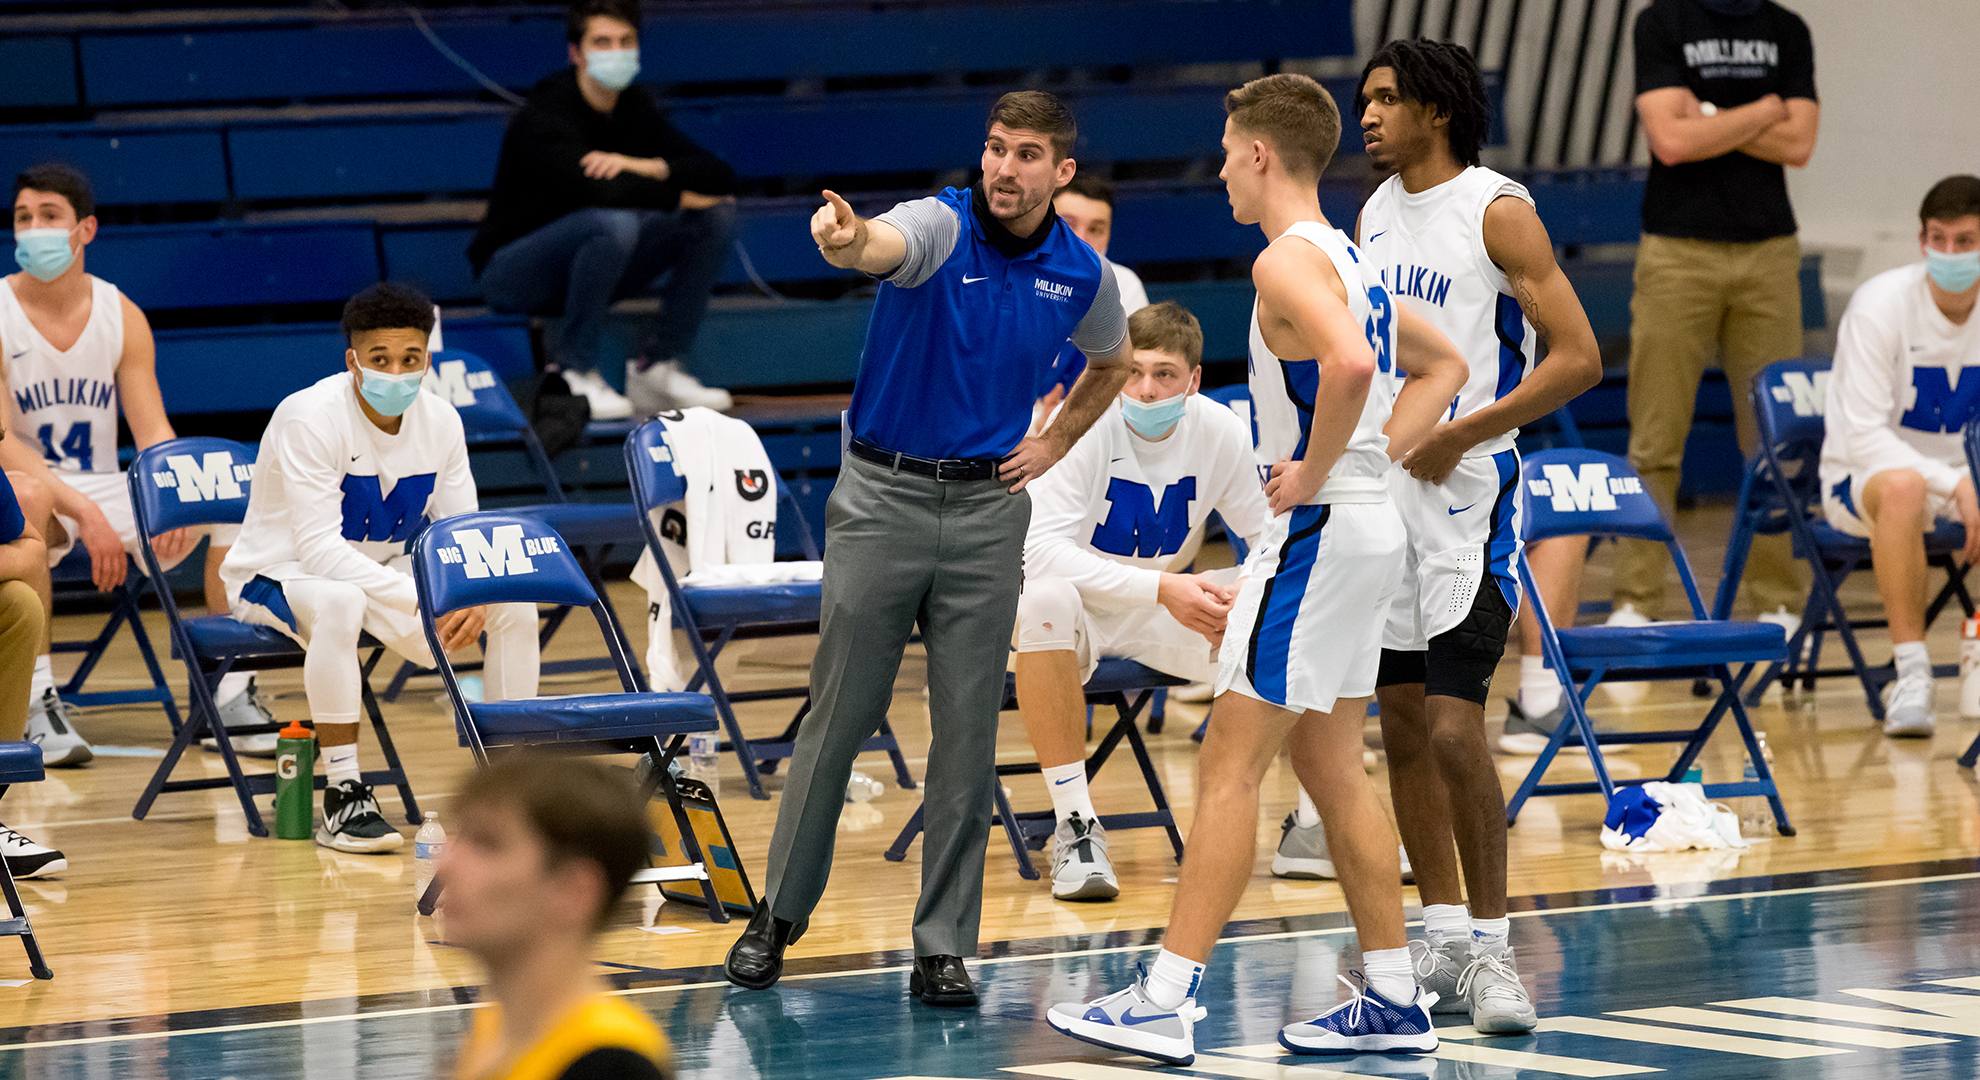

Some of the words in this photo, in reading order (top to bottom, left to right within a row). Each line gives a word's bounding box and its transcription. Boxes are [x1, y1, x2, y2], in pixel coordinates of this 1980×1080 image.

[1034, 278, 1073, 297] MILLIKIN
[15, 378, 114, 414] MILLIKIN
[38, 421, 92, 471] 14
[152, 471, 177, 488] BIG
[166, 451, 241, 502] M
[233, 463, 256, 482] BLU
[1542, 463, 1617, 512] M
[1608, 477, 1643, 494] BLUE
[340, 472, 437, 543] M
[1090, 476, 1196, 558] M
[437, 547, 463, 564] BIG
[451, 524, 534, 579] M
[525, 537, 560, 556] BLUE
[278, 754, 298, 780] G
